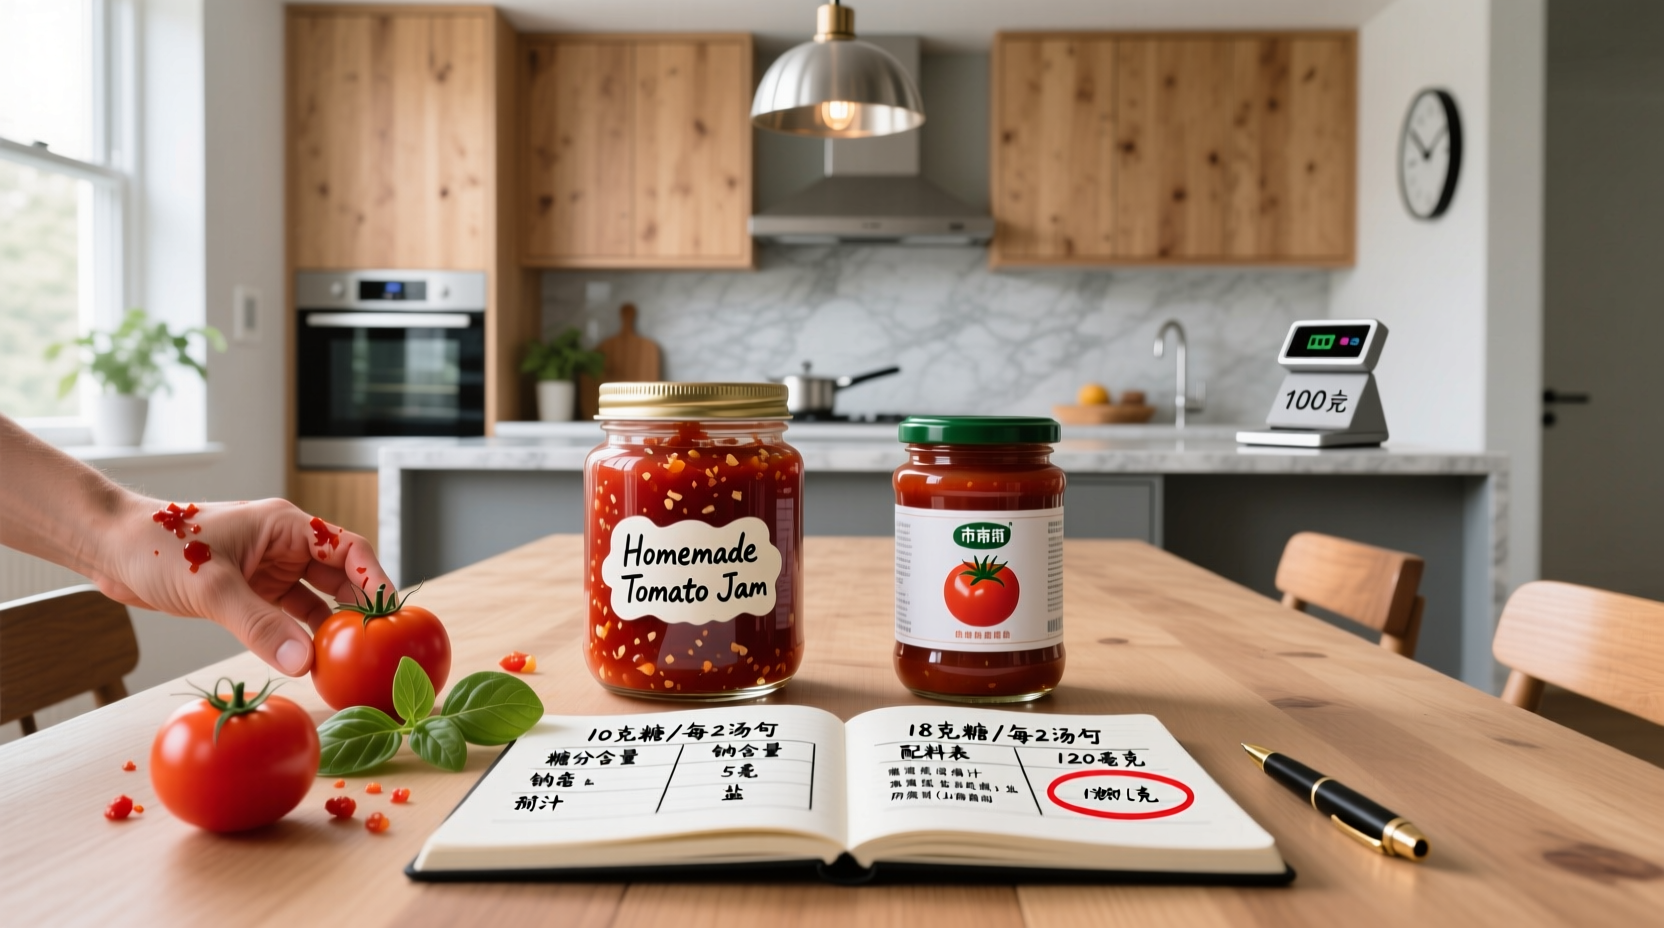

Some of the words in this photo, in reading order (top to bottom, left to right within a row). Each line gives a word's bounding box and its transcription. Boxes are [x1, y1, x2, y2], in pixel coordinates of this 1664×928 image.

[623, 531, 758, 568] Homemade
[621, 573, 709, 604] Tomato
[716, 571, 768, 602] Jam
[899, 743, 971, 761] 配料表
